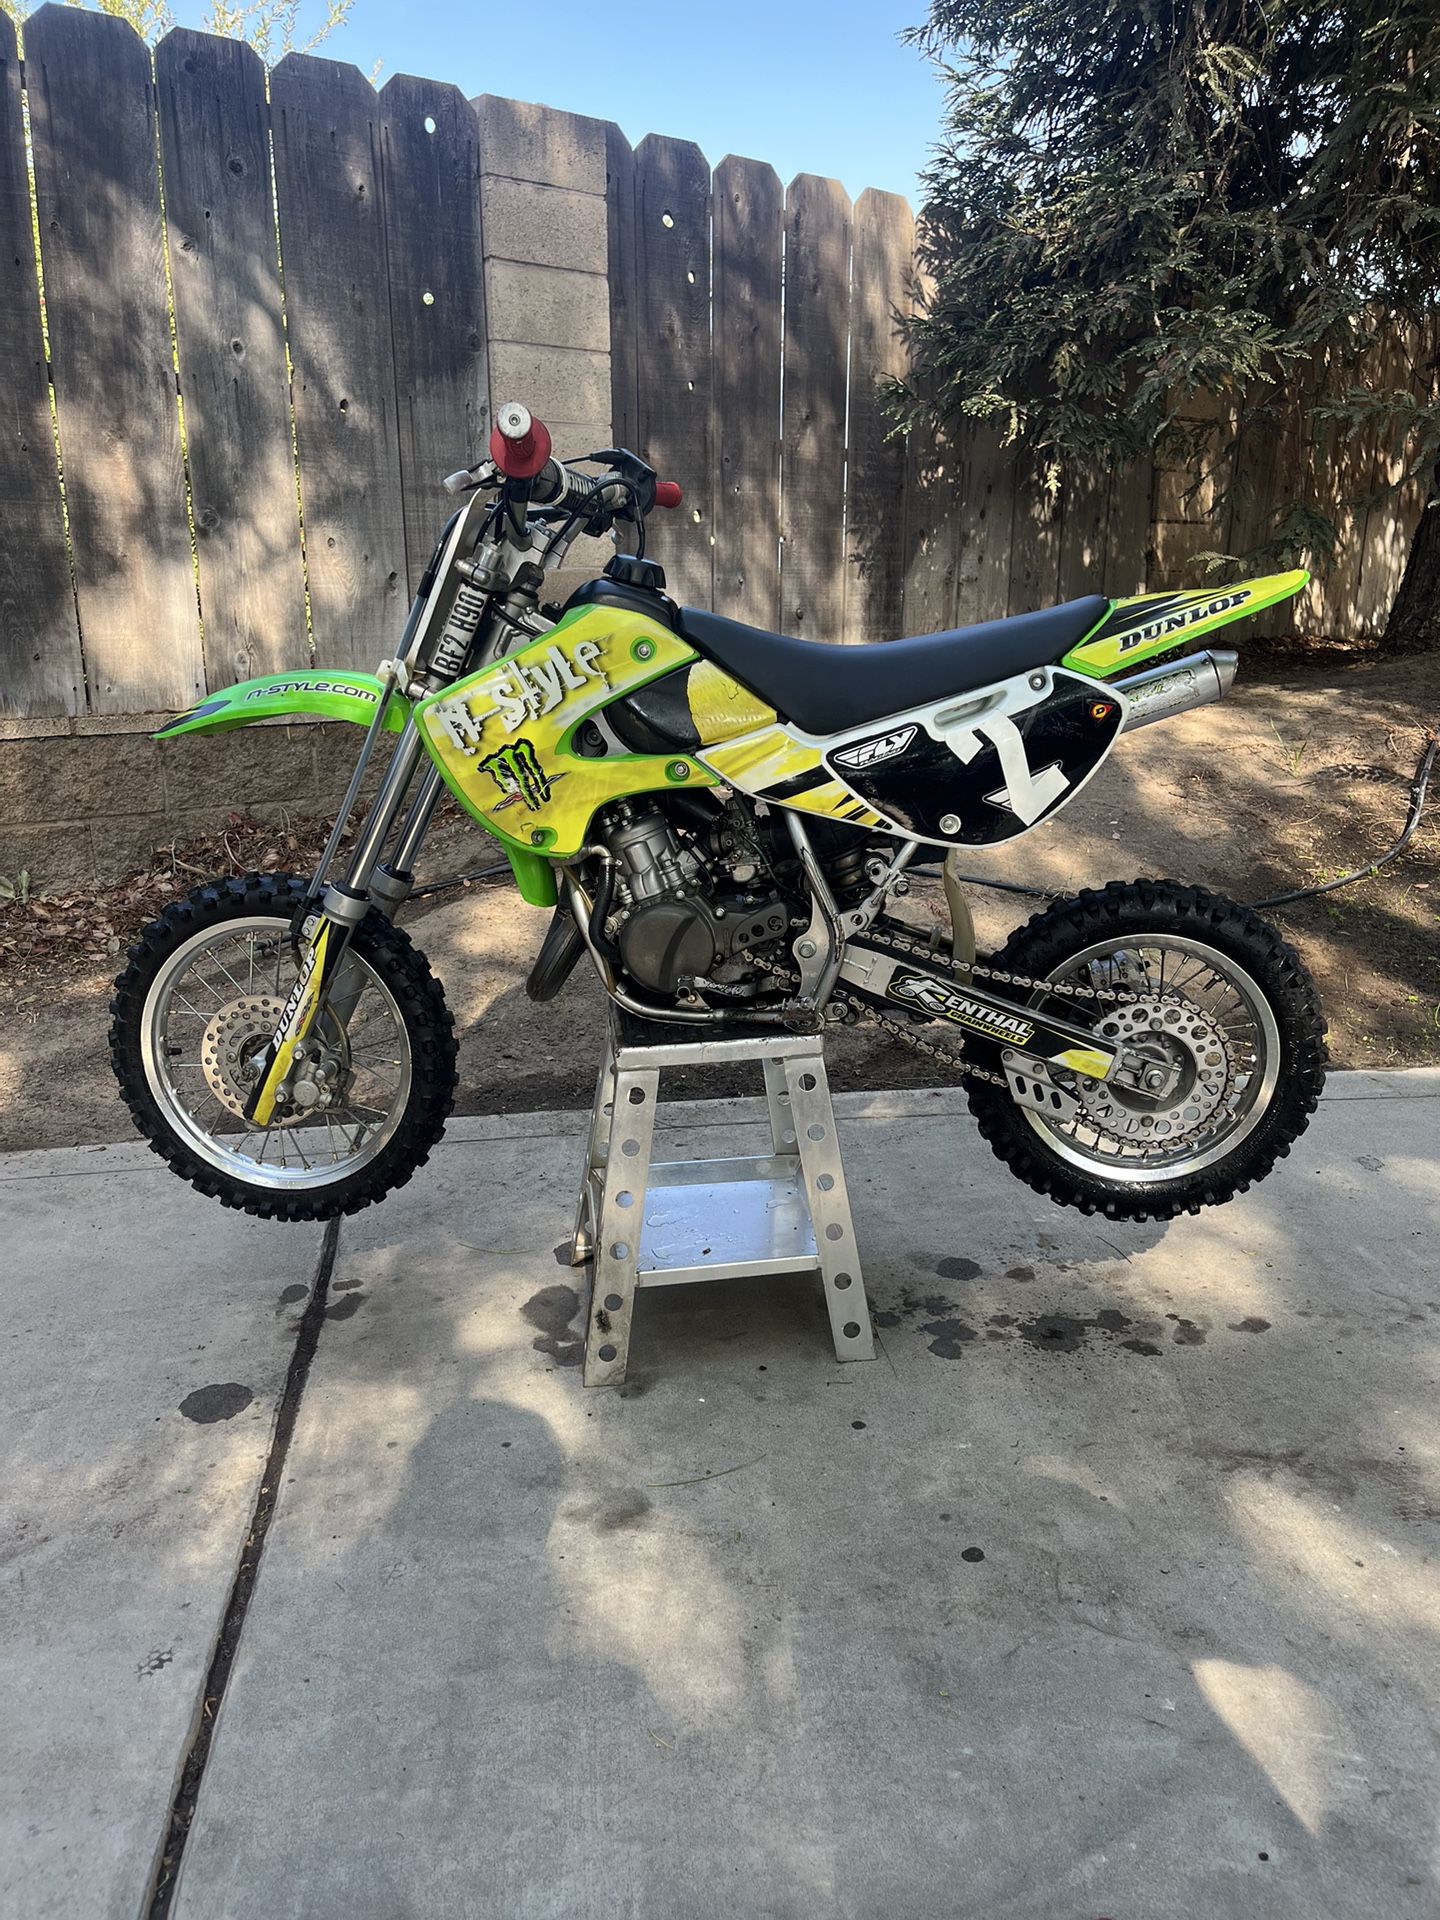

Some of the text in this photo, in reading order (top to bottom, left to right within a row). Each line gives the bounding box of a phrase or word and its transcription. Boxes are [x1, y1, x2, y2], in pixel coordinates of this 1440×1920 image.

[448, 591, 485, 633] H90
[1119, 590, 1252, 653] DUNLOP
[434, 633, 470, 672] BF2
[836, 729, 915, 766] FLY
[272, 946, 316, 1052] DUNLOP
[950, 1010, 1026, 1044] CHAINWHEELS
